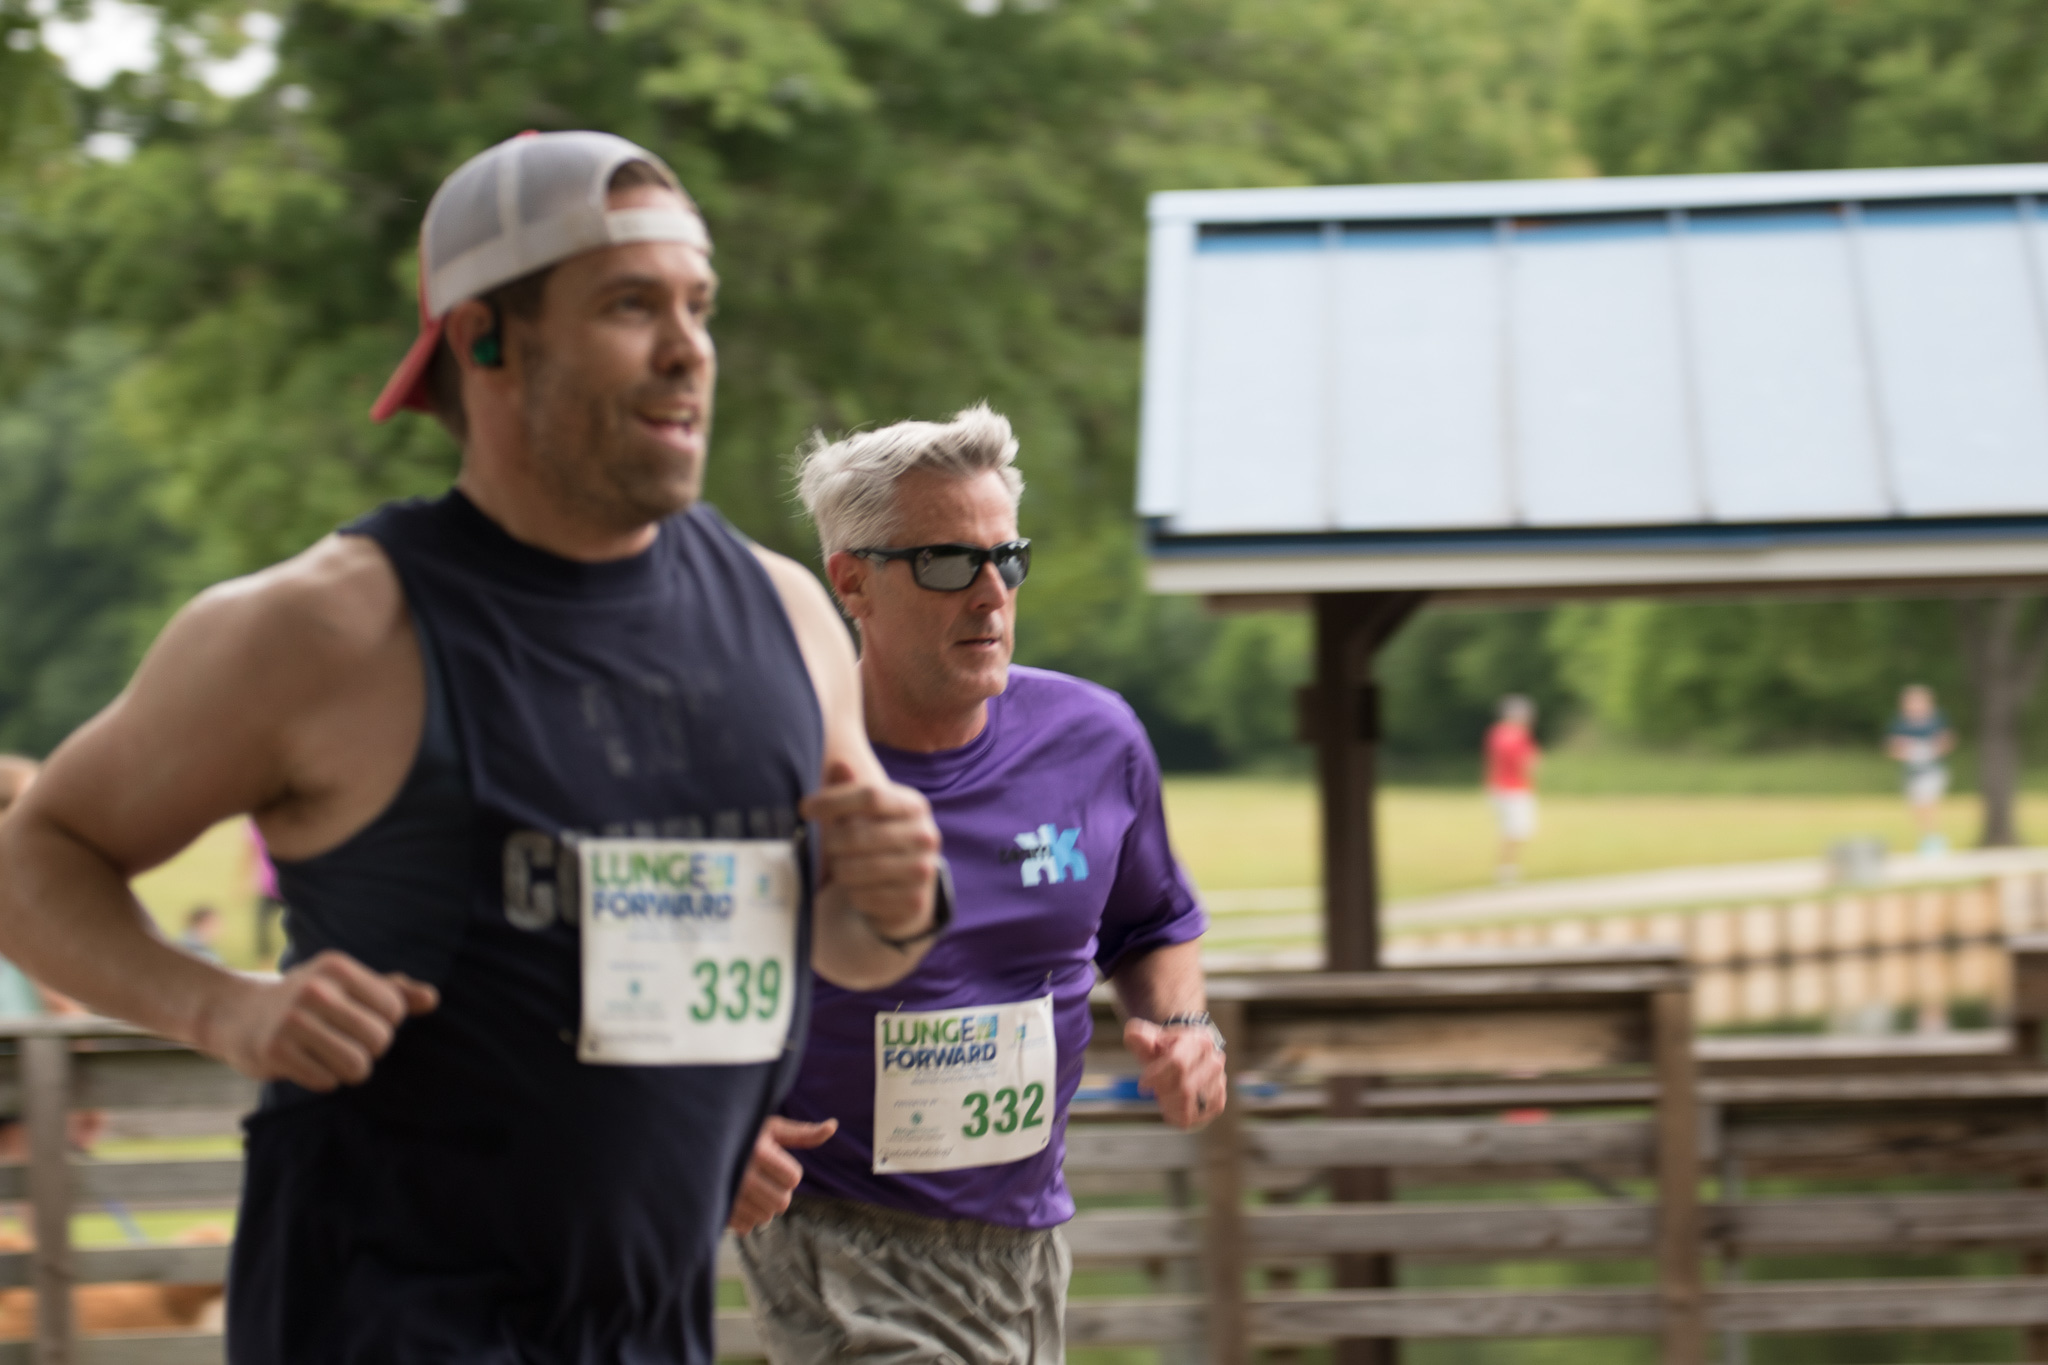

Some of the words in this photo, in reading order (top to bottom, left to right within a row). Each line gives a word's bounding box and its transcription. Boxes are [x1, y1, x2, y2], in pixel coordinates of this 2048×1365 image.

[592, 853, 706, 889] LUNGE
[593, 891, 734, 919] FORWARD
[690, 959, 783, 1022] 339
[883, 1016, 975, 1046] LUNGE
[883, 1043, 997, 1072] FORWARD
[961, 1082, 1045, 1138] 332
